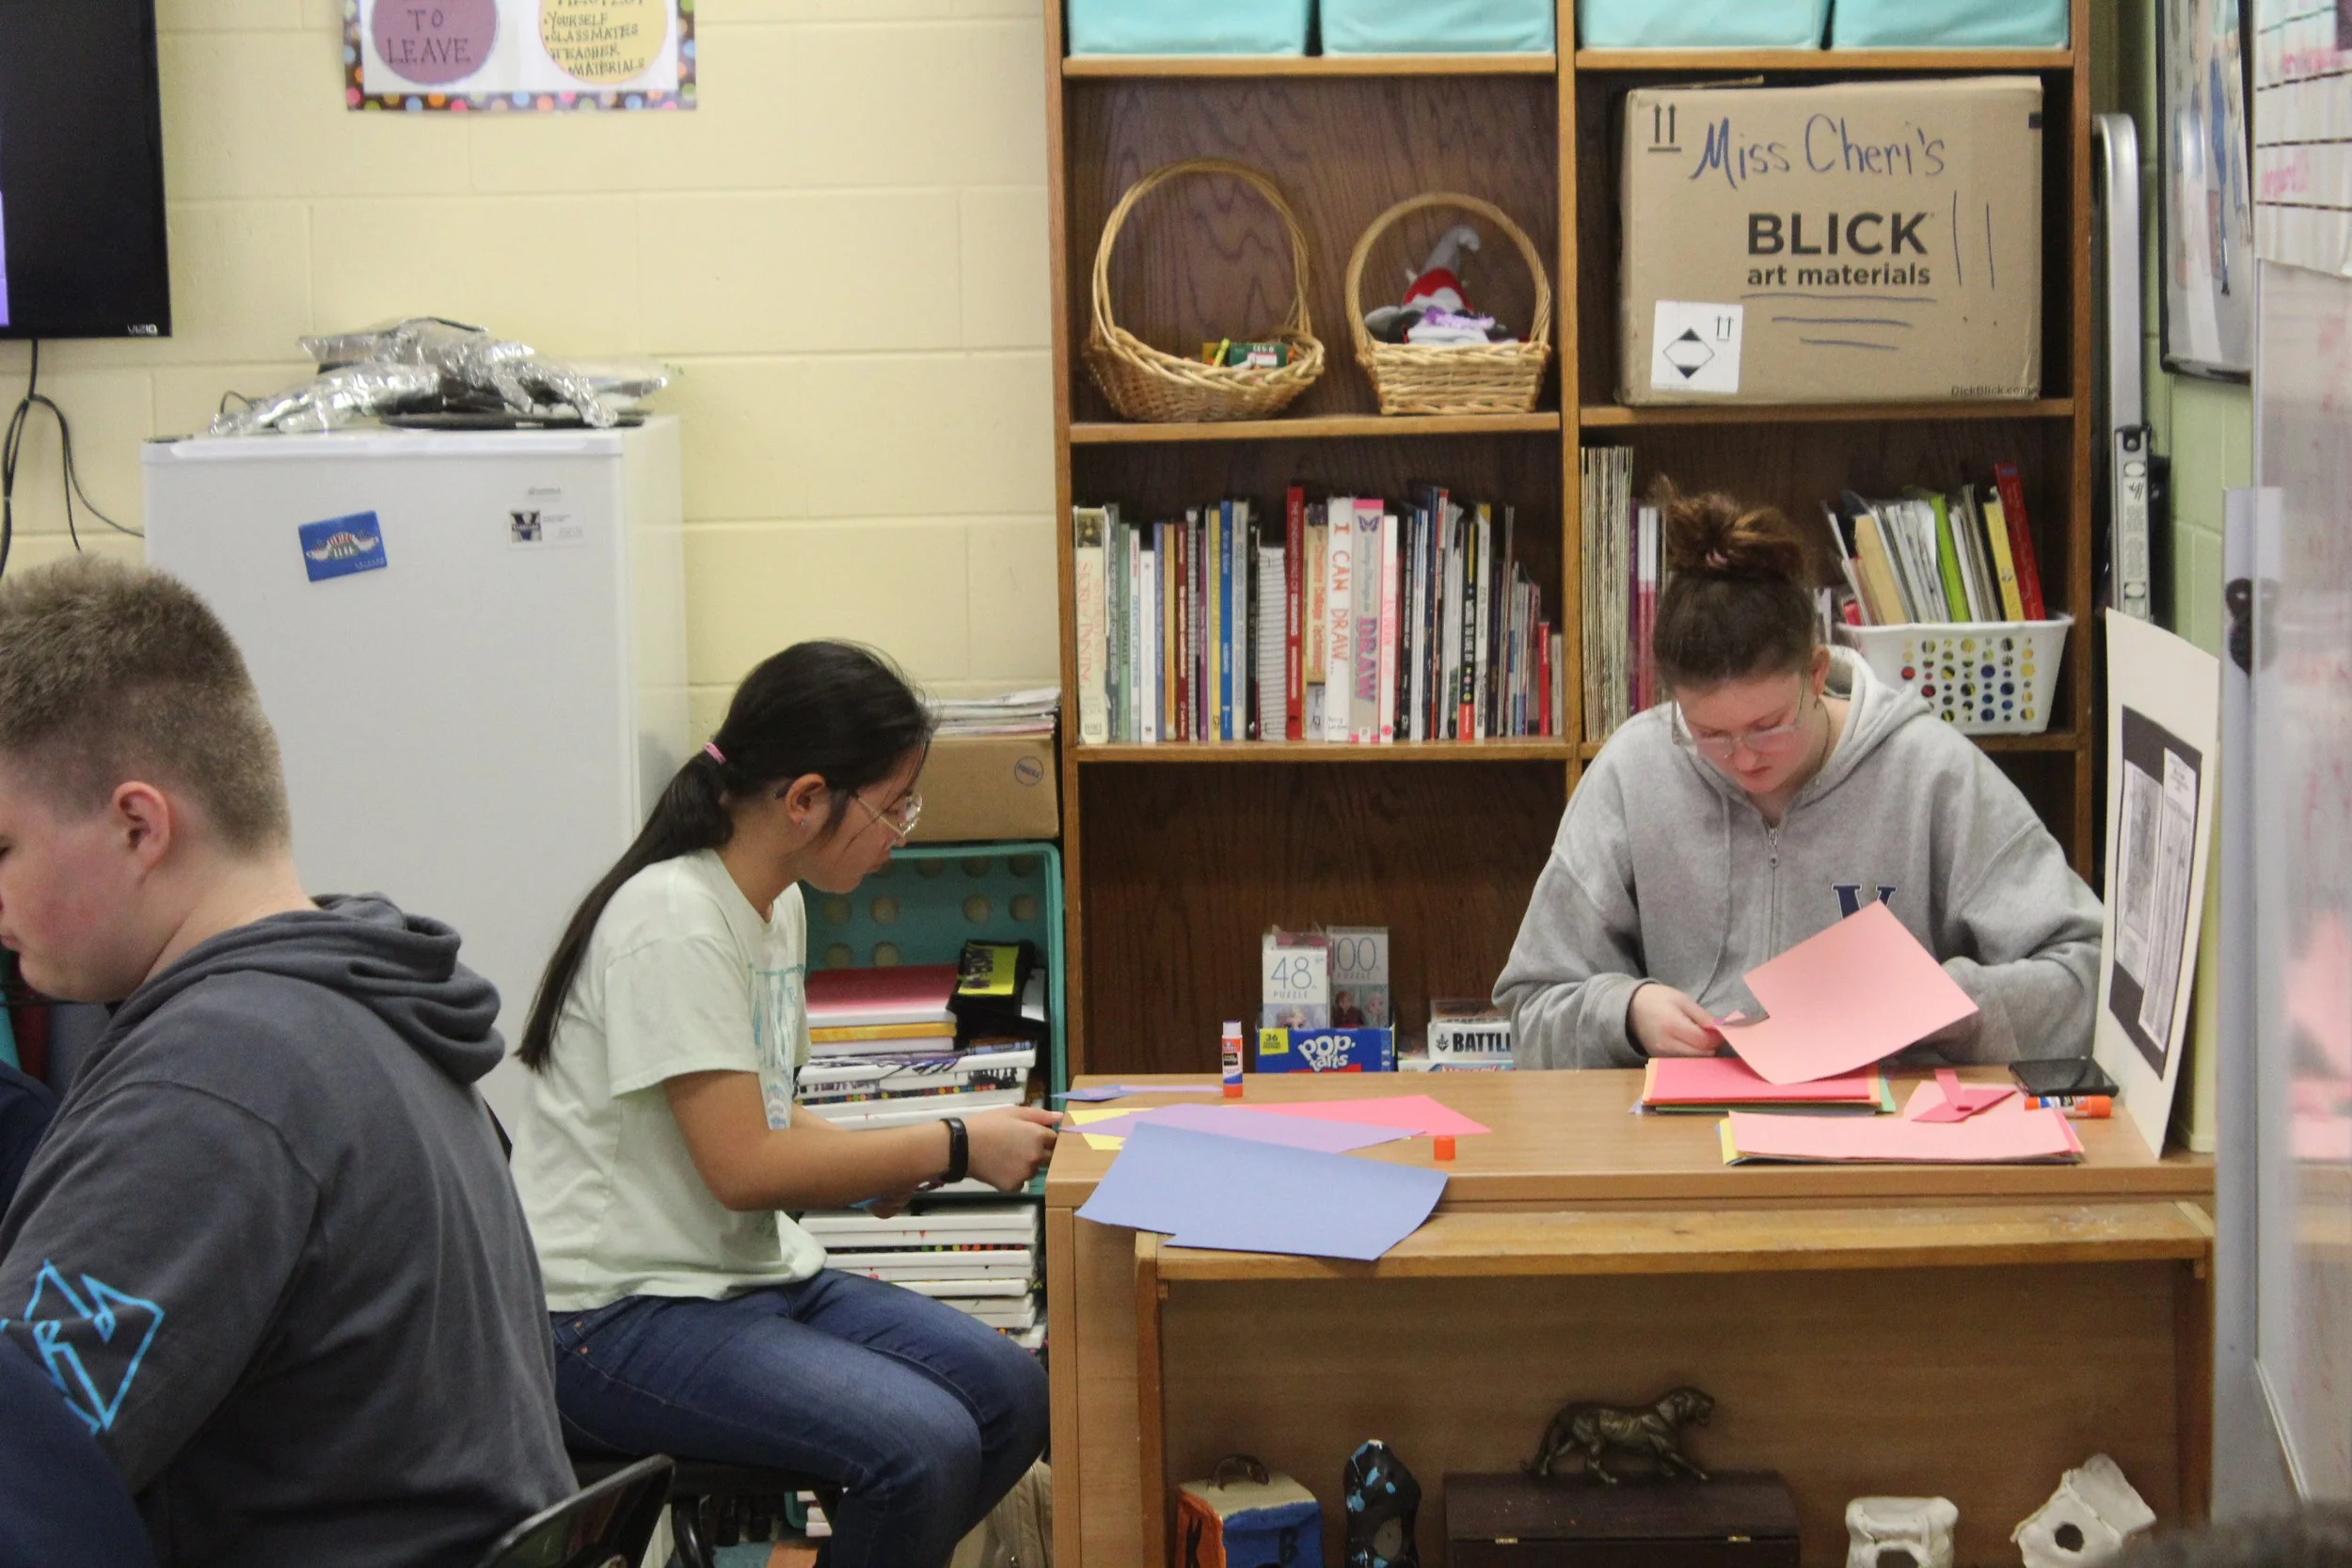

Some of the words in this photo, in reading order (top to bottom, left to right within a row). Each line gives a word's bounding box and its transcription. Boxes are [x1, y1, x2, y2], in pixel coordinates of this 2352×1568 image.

[407, 8, 444, 32] TO
[547, 11, 608, 31] YOURSELF
[550, 24, 639, 41] CLASSMATES
[387, 37, 470, 65] LEAVE
[572, 57, 645, 77] MATERIALS
[1689, 116, 1790, 188] Miss
[1804, 113, 1946, 178] Cheri's
[1748, 212, 1928, 256] BLICK
[1747, 264, 1787, 286] art
[1797, 262, 1931, 286] materials
[1333, 522, 1351, 535] I
[1332, 549, 1350, 592] CAN
[1355, 616, 1378, 704] DRAW
[1270, 956, 1312, 990] 48
